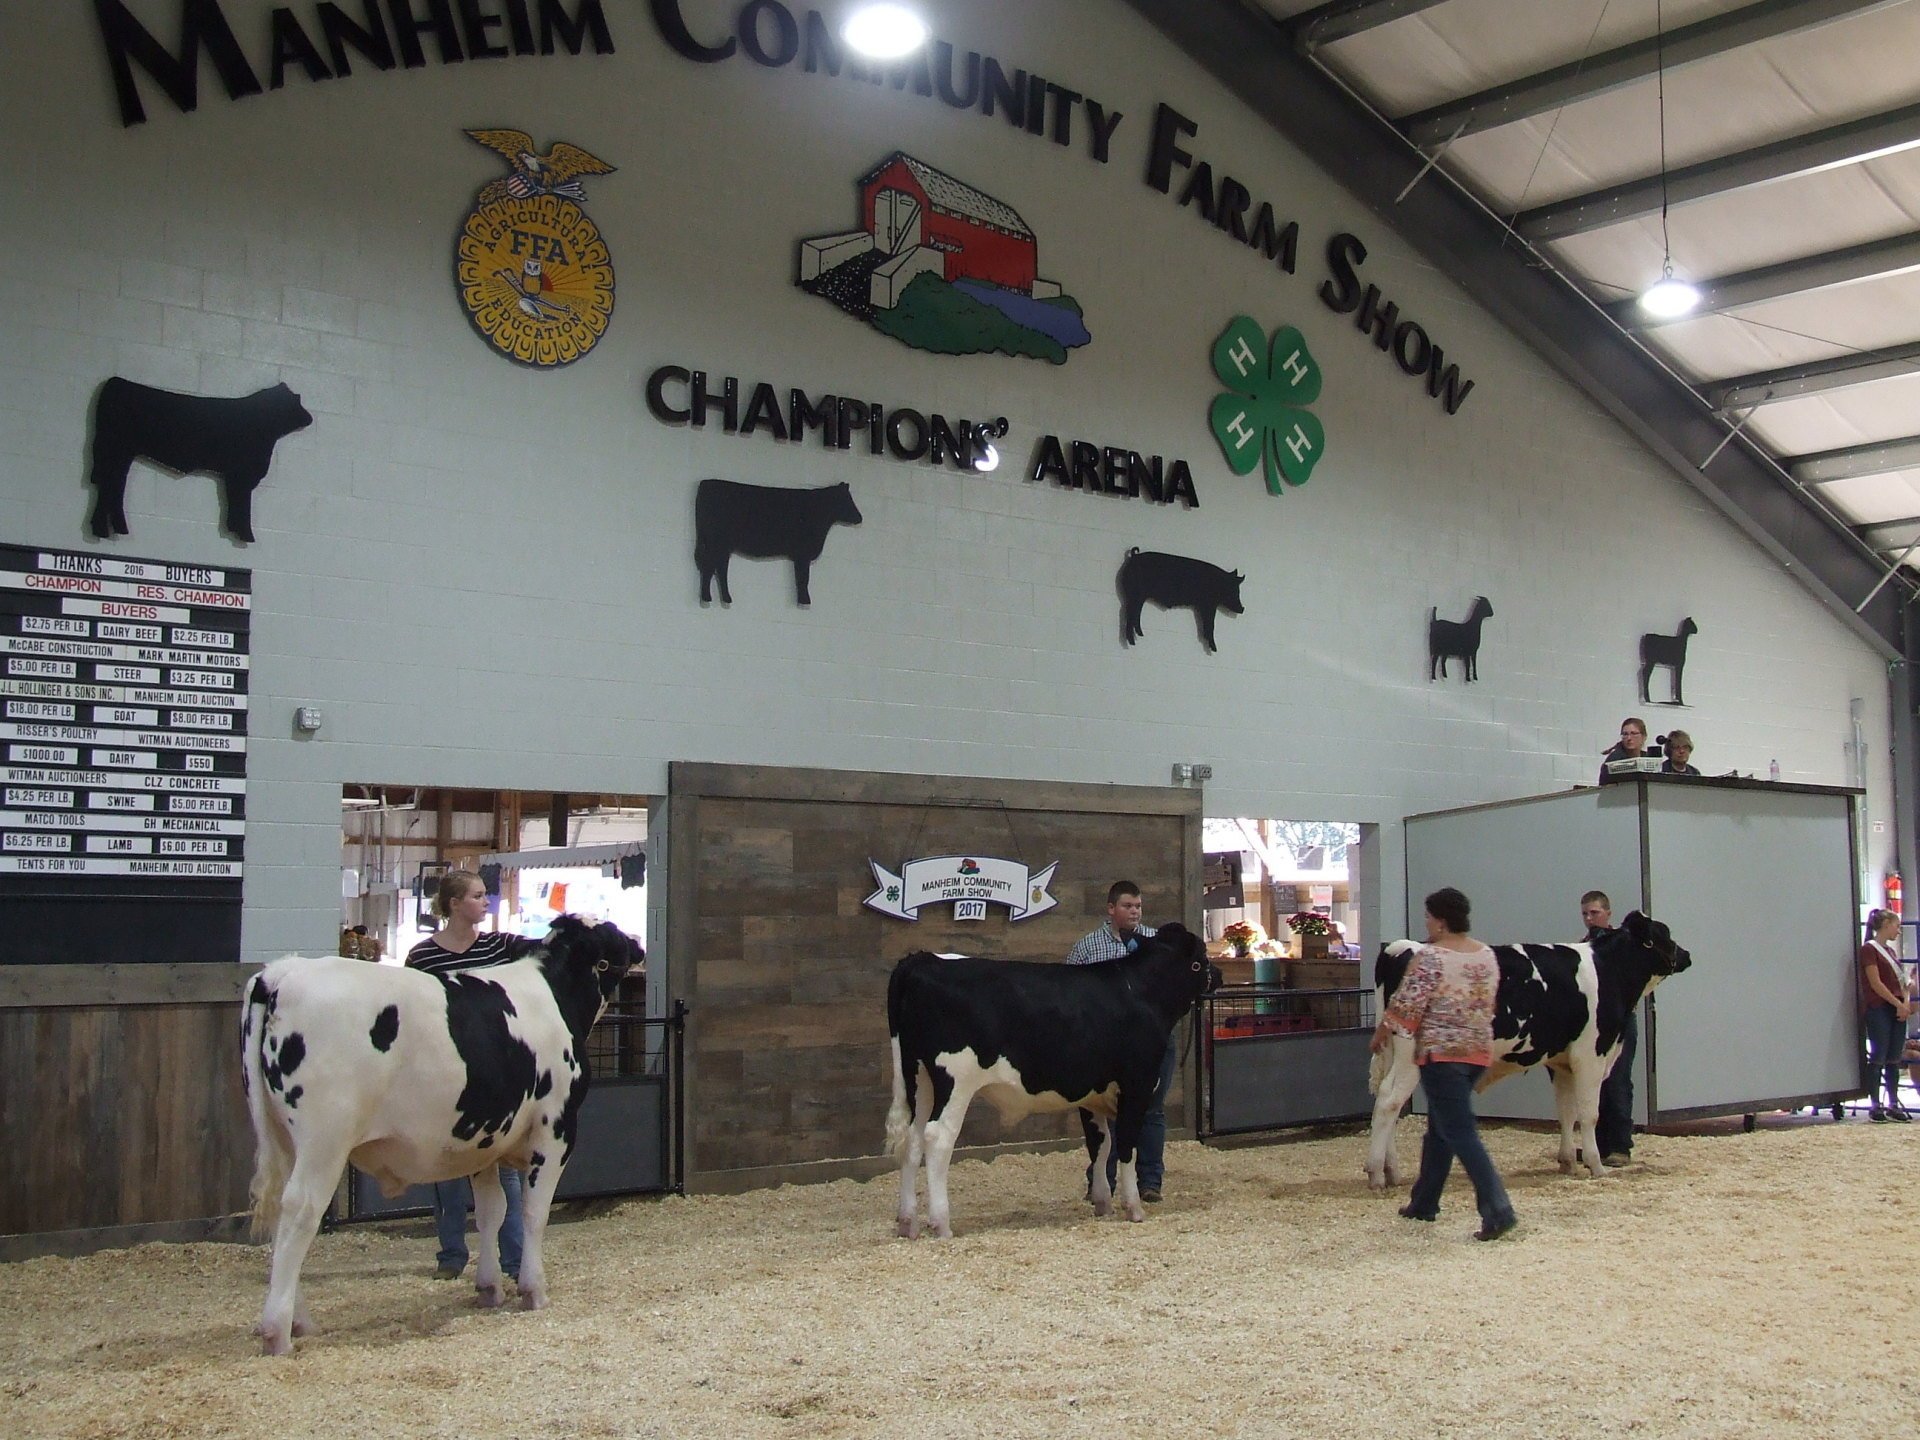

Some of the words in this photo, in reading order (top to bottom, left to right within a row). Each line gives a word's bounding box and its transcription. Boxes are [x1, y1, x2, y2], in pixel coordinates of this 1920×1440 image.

[97, 0, 615, 128] MANHEIM
[1146, 103, 1299, 275] FARM
[1320, 232, 1475, 415] SHOW
[485, 211, 593, 274] AGRICULTURAL
[511, 229, 569, 266] FFA
[491, 298, 582, 339] EDUCATION
[1031, 435, 1200, 508] ARENA
[53, 554, 102, 573] THANKS
[125, 563, 144, 577] 2016
[166, 565, 212, 584] BUYERS
[25, 574, 101, 592] CHAMPION
[137, 585, 168, 600] RES.
[173, 589, 244, 607] CHAMPION
[101, 602, 157, 619] BUYERS
[25, 618, 51, 630] $2.75
[54, 620, 70, 631] PER
[73, 622, 87, 633] LB.
[103, 625, 130, 638] DAIRY
[135, 627, 158, 639] BEEF
[174, 630, 198, 642] $2.25
[201, 632, 216, 644] PER
[219, 634, 232, 645] LB.
[8, 639, 44, 652] McCABE
[48, 643, 113, 656] CONSTRUCTION
[138, 649, 163, 660] MARK
[168, 651, 201, 663] MARTIN
[206, 655, 241, 667] MOTORS
[10, 660, 37, 671] $5.00
[40, 662, 57, 673] PER
[60, 664, 74, 675] LB.
[114, 668, 141, 680] STEER
[200, 674, 217, 685] PER
[19, 682, 61, 696] HOLLINGER
[65, 685, 71, 697] &
[74, 686, 96, 699] SONS
[99, 688, 115, 701] INC.
[134, 691, 174, 704] MANHEIM
[176, 694, 198, 705] AUTO
[201, 696, 235, 707] AUCTION
[9, 702, 39, 715] $18.00
[42, 704, 58, 716] PER
[61, 706, 74, 717] LB.
[114, 710, 136, 722] GOAT
[172, 712, 197, 724] $8.00
[200, 714, 215, 725] PER
[218, 715, 231, 727] LB.
[16, 725, 58, 738] RISSER'S
[61, 727, 98, 740] POULTRY
[138, 734, 172, 746] WITMAN
[174, 735, 230, 749] AUCTIONEERS
[109, 752, 136, 764] DAIRY
[189, 758, 211, 769] $550
[8, 769, 44, 781] WITMAN
[47, 771, 108, 784] AUCTIONEERS
[144, 776, 163, 788] CLZ
[169, 778, 220, 790] CONCRETE
[8, 789, 35, 801] $4.25
[38, 791, 54, 802] PER
[57, 791, 72, 803] LB.
[107, 795, 136, 807] SWINE
[171, 798, 197, 810] $5.00
[200, 800, 215, 810] PER
[217, 800, 231, 812] LB.
[25, 814, 55, 825] MATCO
[58, 815, 86, 826] TOOLS
[144, 818, 157, 829] GH
[162, 819, 221, 832] MECHANICAL
[5, 835, 32, 846] $6.25
[36, 836, 52, 847] PER
[56, 837, 70, 848] LB.
[107, 839, 132, 851] LAMB
[191, 842, 208, 853] PER
[18, 859, 45, 870] TENTS
[48, 860, 66, 870] FOR
[68, 860, 86, 871] YOU
[129, 862, 170, 874] MANHEIM
[172, 863, 194, 874] AUTO
[196, 864, 232, 875] AUCTION
[921, 878, 961, 892] MANHEIM
[963, 877, 1013, 892] COMMUNITY
[941, 888, 965, 899] FARM
[967, 888, 993, 899] SHOW
[958, 902, 984, 917] 2017
